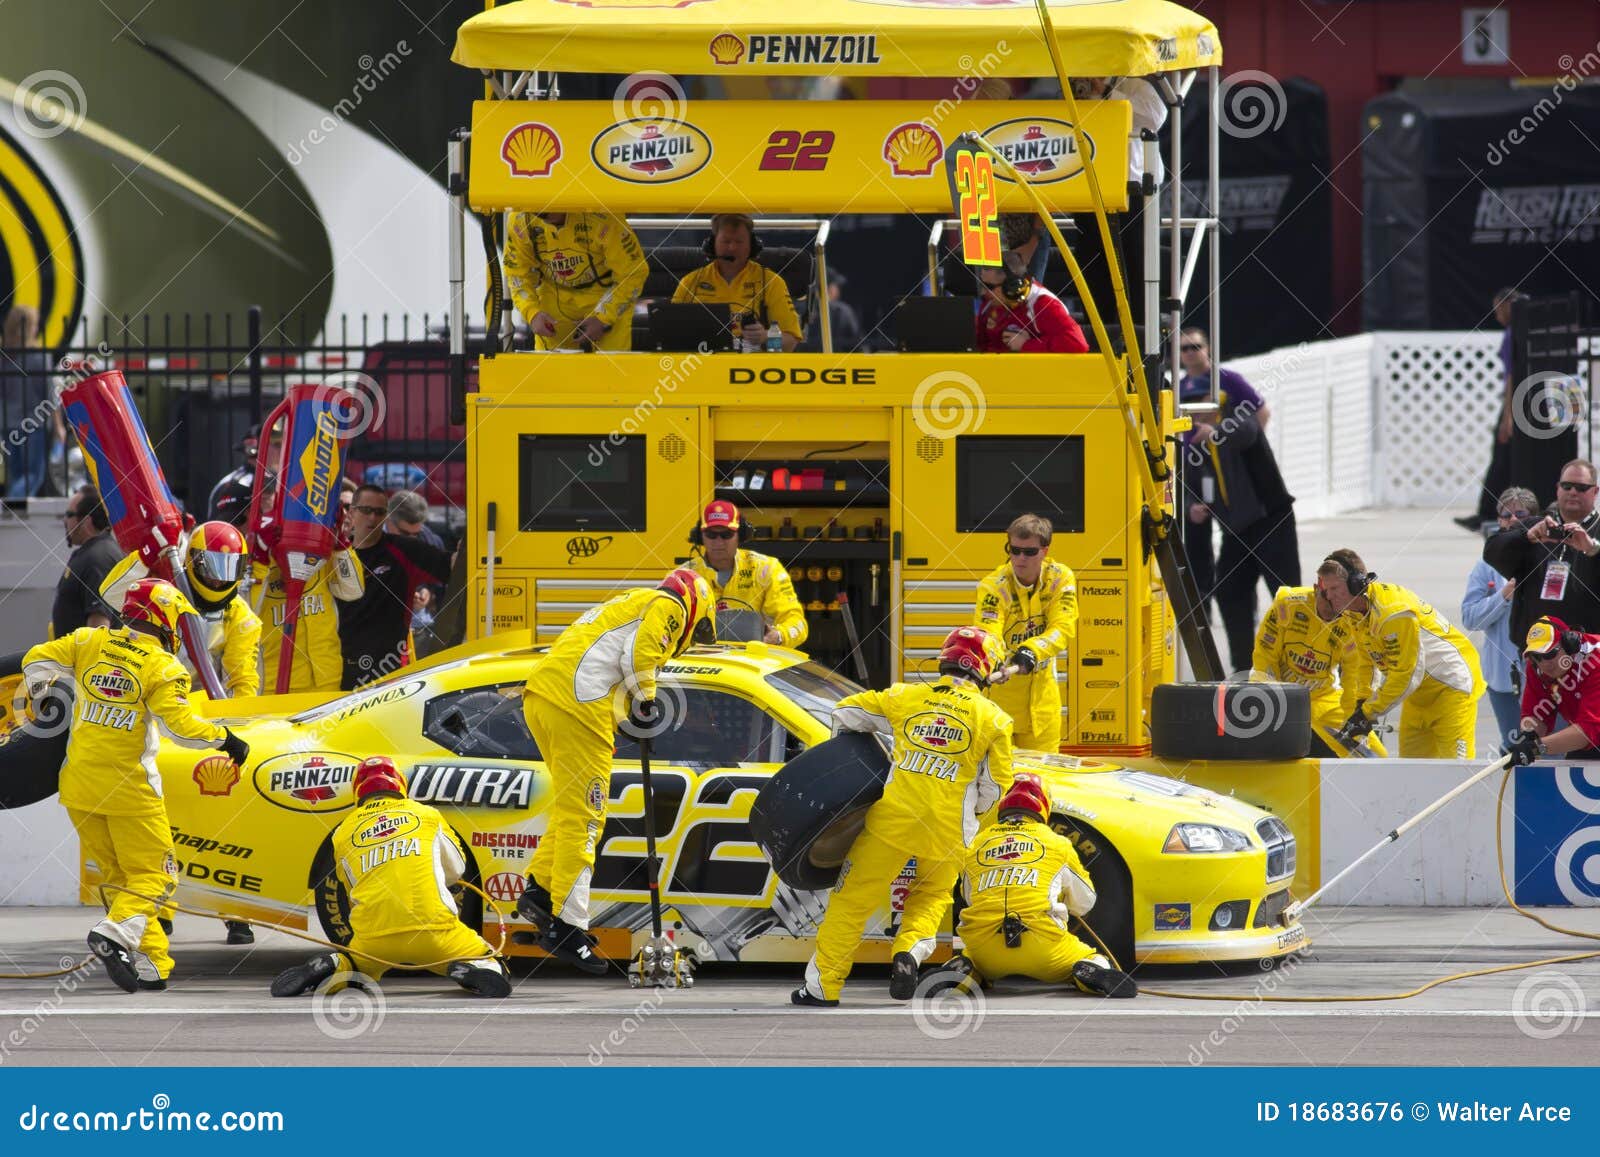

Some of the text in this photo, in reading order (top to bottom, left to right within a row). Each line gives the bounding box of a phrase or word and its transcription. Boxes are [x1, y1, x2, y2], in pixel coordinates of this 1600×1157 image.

[748, 34, 881, 64] PENNZOIL
[609, 136, 694, 164] PENNZOIL
[758, 130, 835, 172] 22
[956, 149, 1003, 267] 22
[729, 368, 877, 386] DODGE
[309, 412, 338, 515] SUNOCO
[1082, 586, 1122, 596] Mazak
[271, 594, 326, 627] URA
[480, 615, 524, 623] DSCOUNT
[1093, 618, 1123, 626] BOSCH
[661, 665, 723, 675] BUSCH
[81, 700, 138, 731] ULTRA
[339, 684, 409, 722] LENNOX
[912, 725, 964, 741] PENNZOIL
[898, 750, 960, 782] ULTRA
[408, 765, 535, 809] ULTRA
[360, 816, 409, 842] PENNZOIL
[588, 768, 778, 900] 22
[361, 838, 420, 874] ULTRA
[491, 848, 525, 859] TIRE
[985, 842, 1035, 860] PENNZOIL
[177, 860, 263, 894] DGE
[487, 873, 527, 902] AAA
[978, 867, 1039, 892] ULTRA
[324, 876, 350, 939] EAGLE
